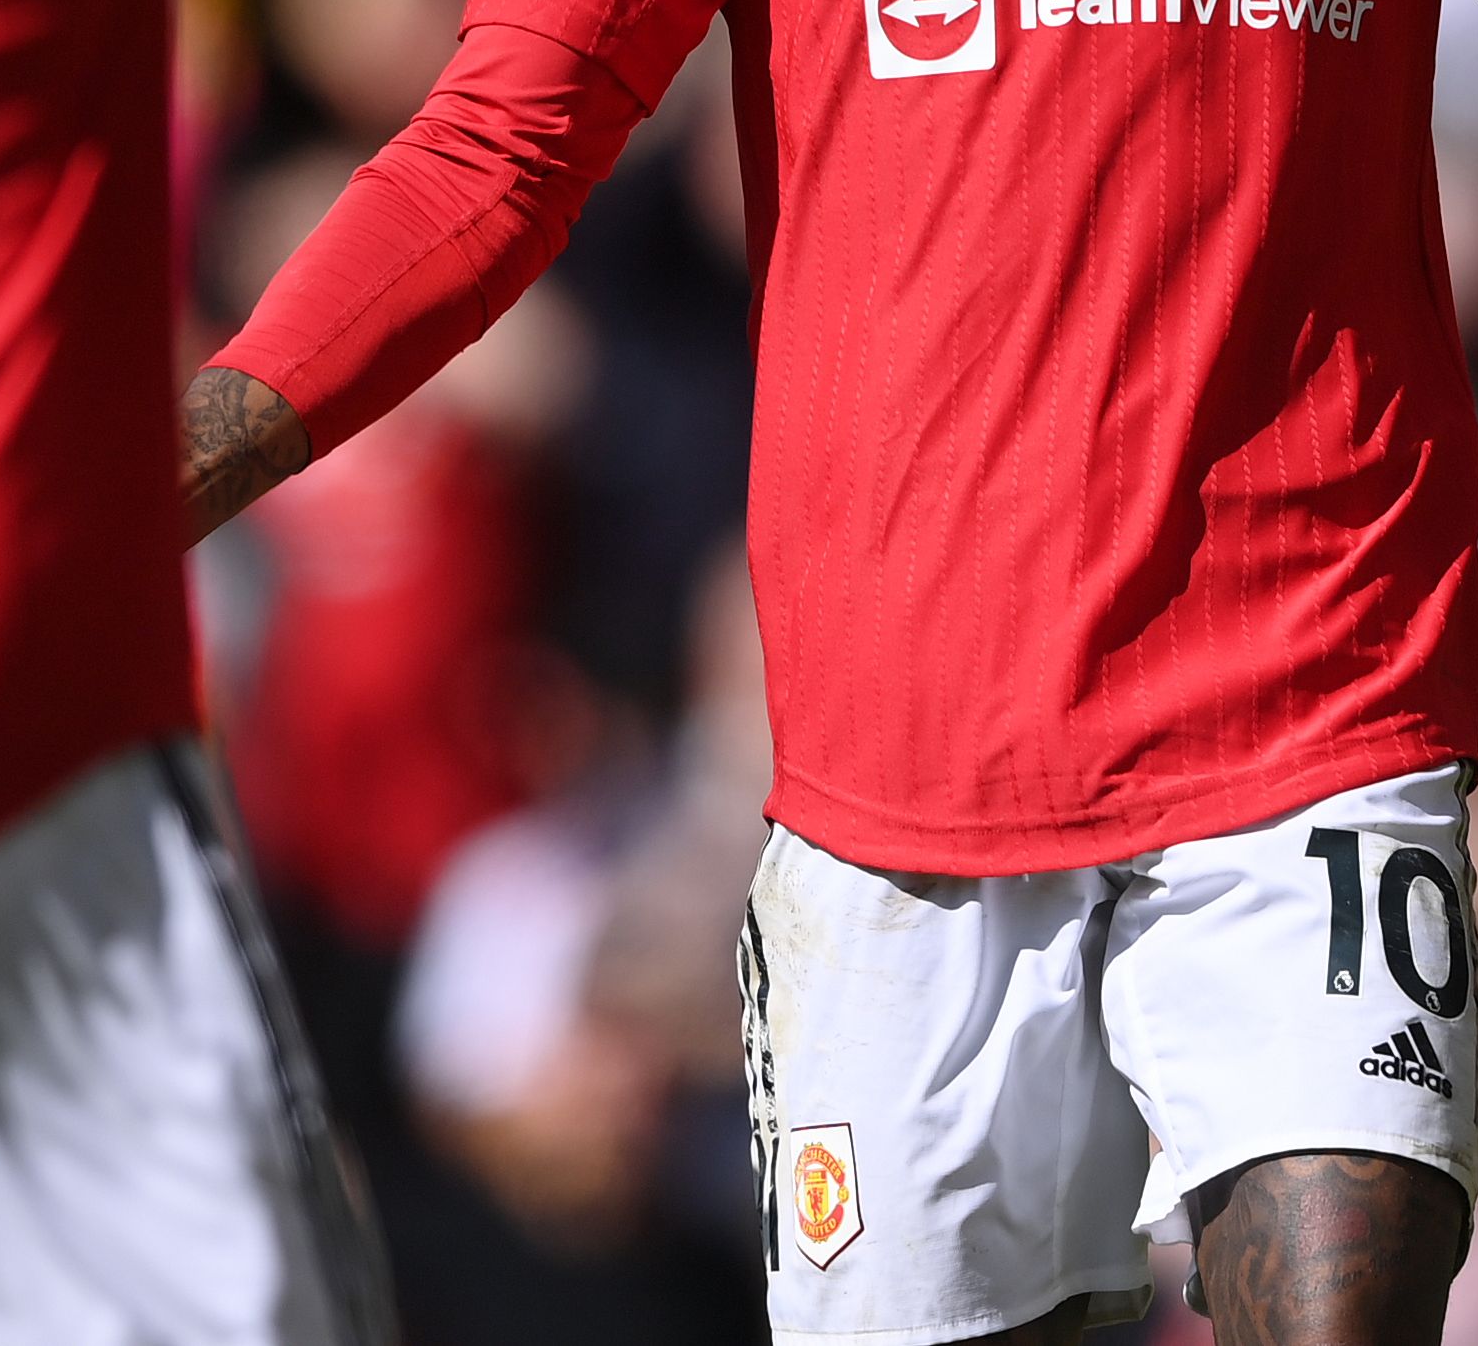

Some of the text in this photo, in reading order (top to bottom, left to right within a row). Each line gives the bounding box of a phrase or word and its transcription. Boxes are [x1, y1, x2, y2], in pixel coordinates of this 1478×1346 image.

[1304, 826, 1470, 1018] 10
[1359, 1056, 1453, 1100] adidas
[802, 1216, 838, 1237] UNITED
